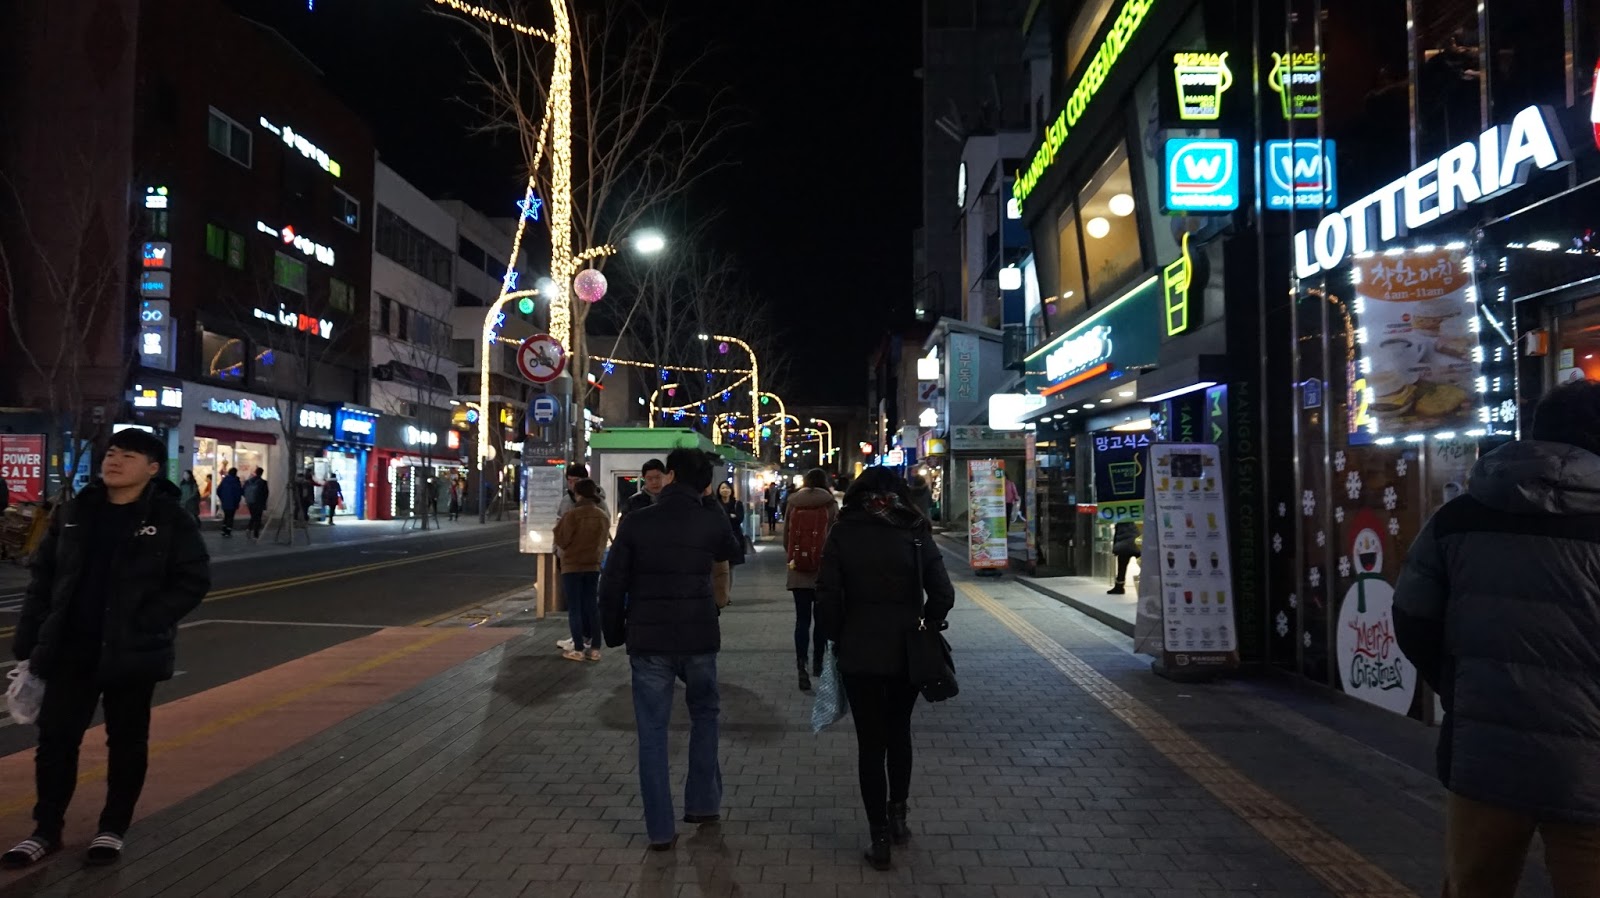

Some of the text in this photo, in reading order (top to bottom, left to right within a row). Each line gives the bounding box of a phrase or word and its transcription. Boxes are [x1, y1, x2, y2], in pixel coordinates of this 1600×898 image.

[1021, 141, 1050, 200] MANGO
[1294, 104, 1560, 280] LOTTERIA
[957, 352, 972, 399] 부동산
[3, 453, 41, 465] POWER
[1096, 434, 1149, 452] 망고식스
[1, 466, 41, 478] SALE
[1102, 505, 1145, 520] OPE
[1354, 618, 1394, 660] Merry
[1351, 653, 1405, 691] Christmas
